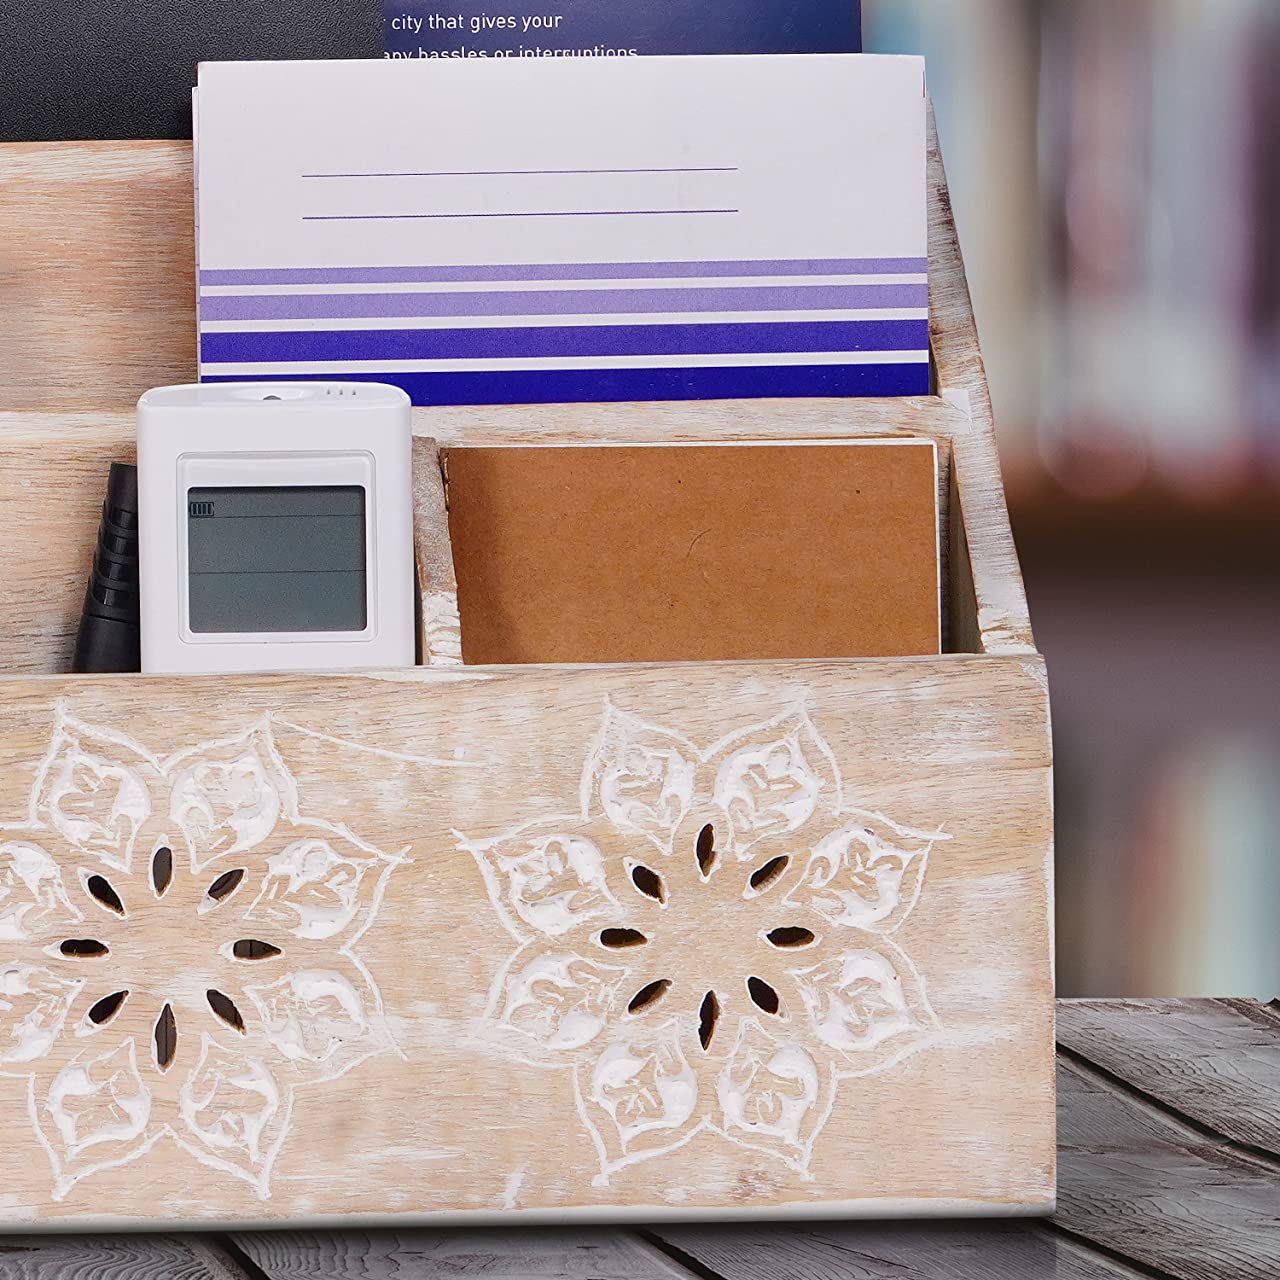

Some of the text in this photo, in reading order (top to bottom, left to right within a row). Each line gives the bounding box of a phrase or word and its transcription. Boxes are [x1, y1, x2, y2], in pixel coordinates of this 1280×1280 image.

[392, 13, 562, 33] city that gives your
